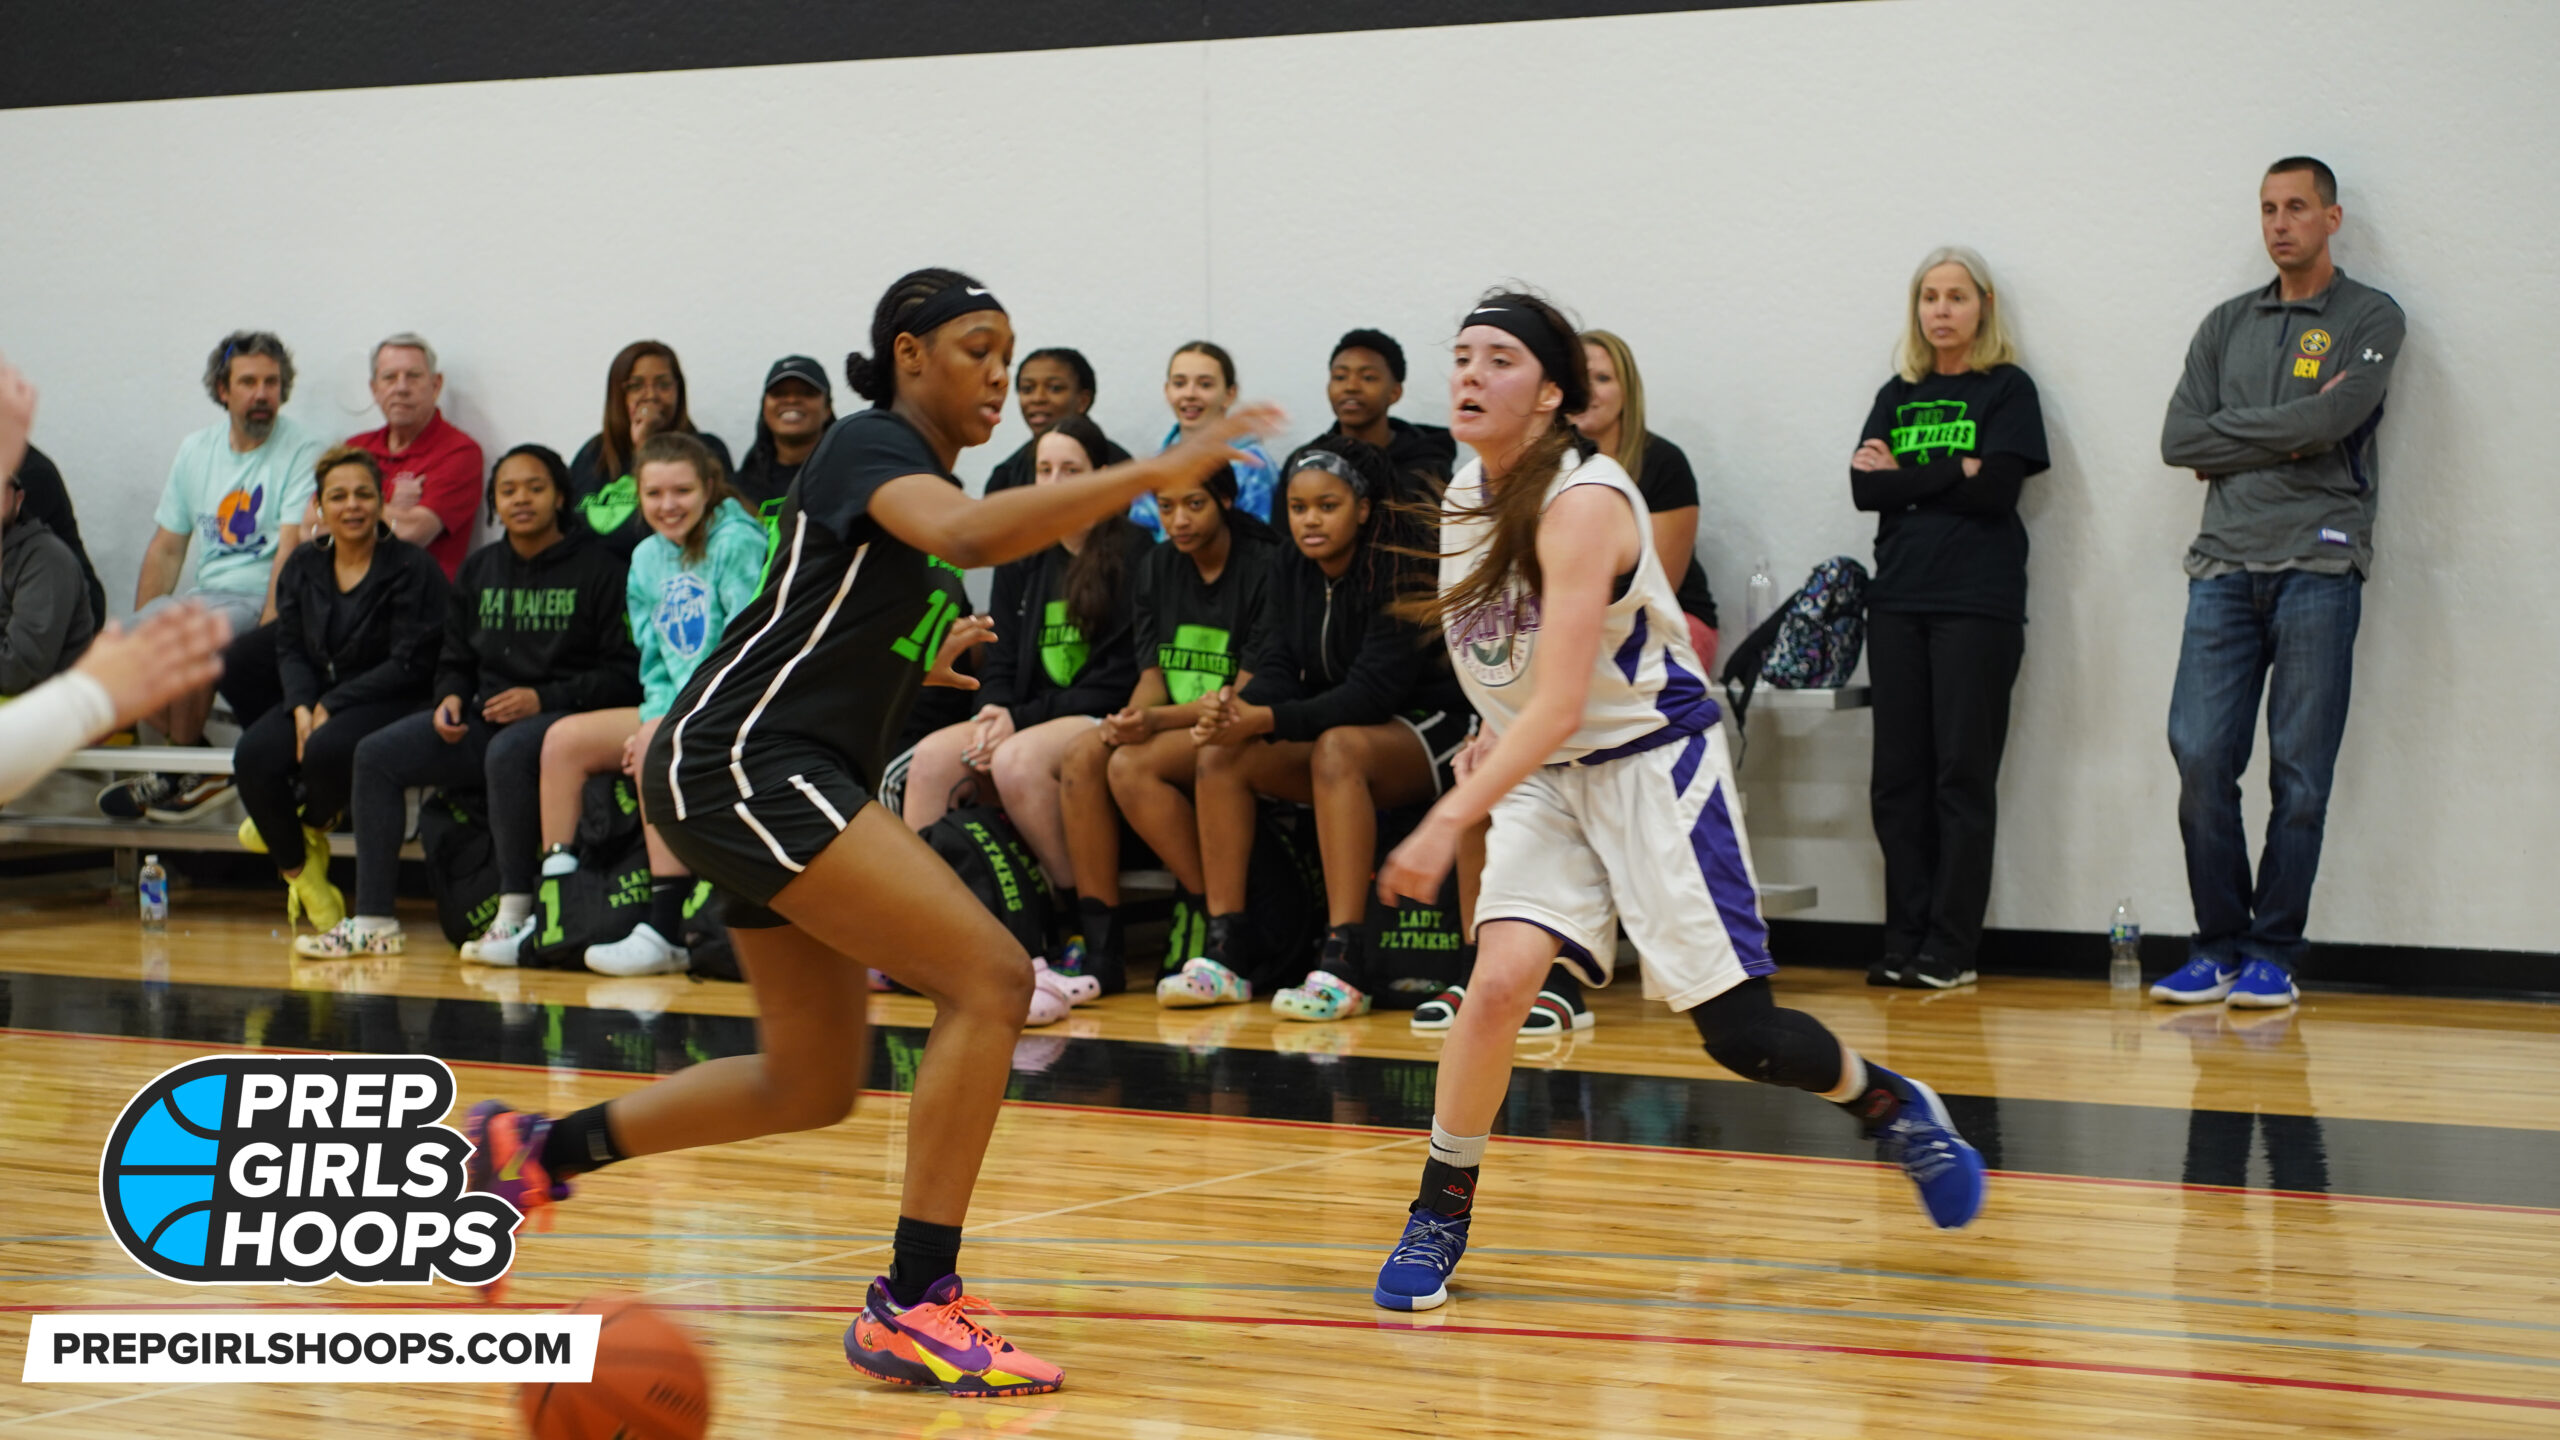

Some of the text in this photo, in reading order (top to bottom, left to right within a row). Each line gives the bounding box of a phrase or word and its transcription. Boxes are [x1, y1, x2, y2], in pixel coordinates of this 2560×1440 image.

[2293, 357, 2320, 379] DEN
[618, 868, 652, 890] LAD
[1398, 909, 1445, 929] LADY
[1379, 930, 1461, 951] PLYMKRS
